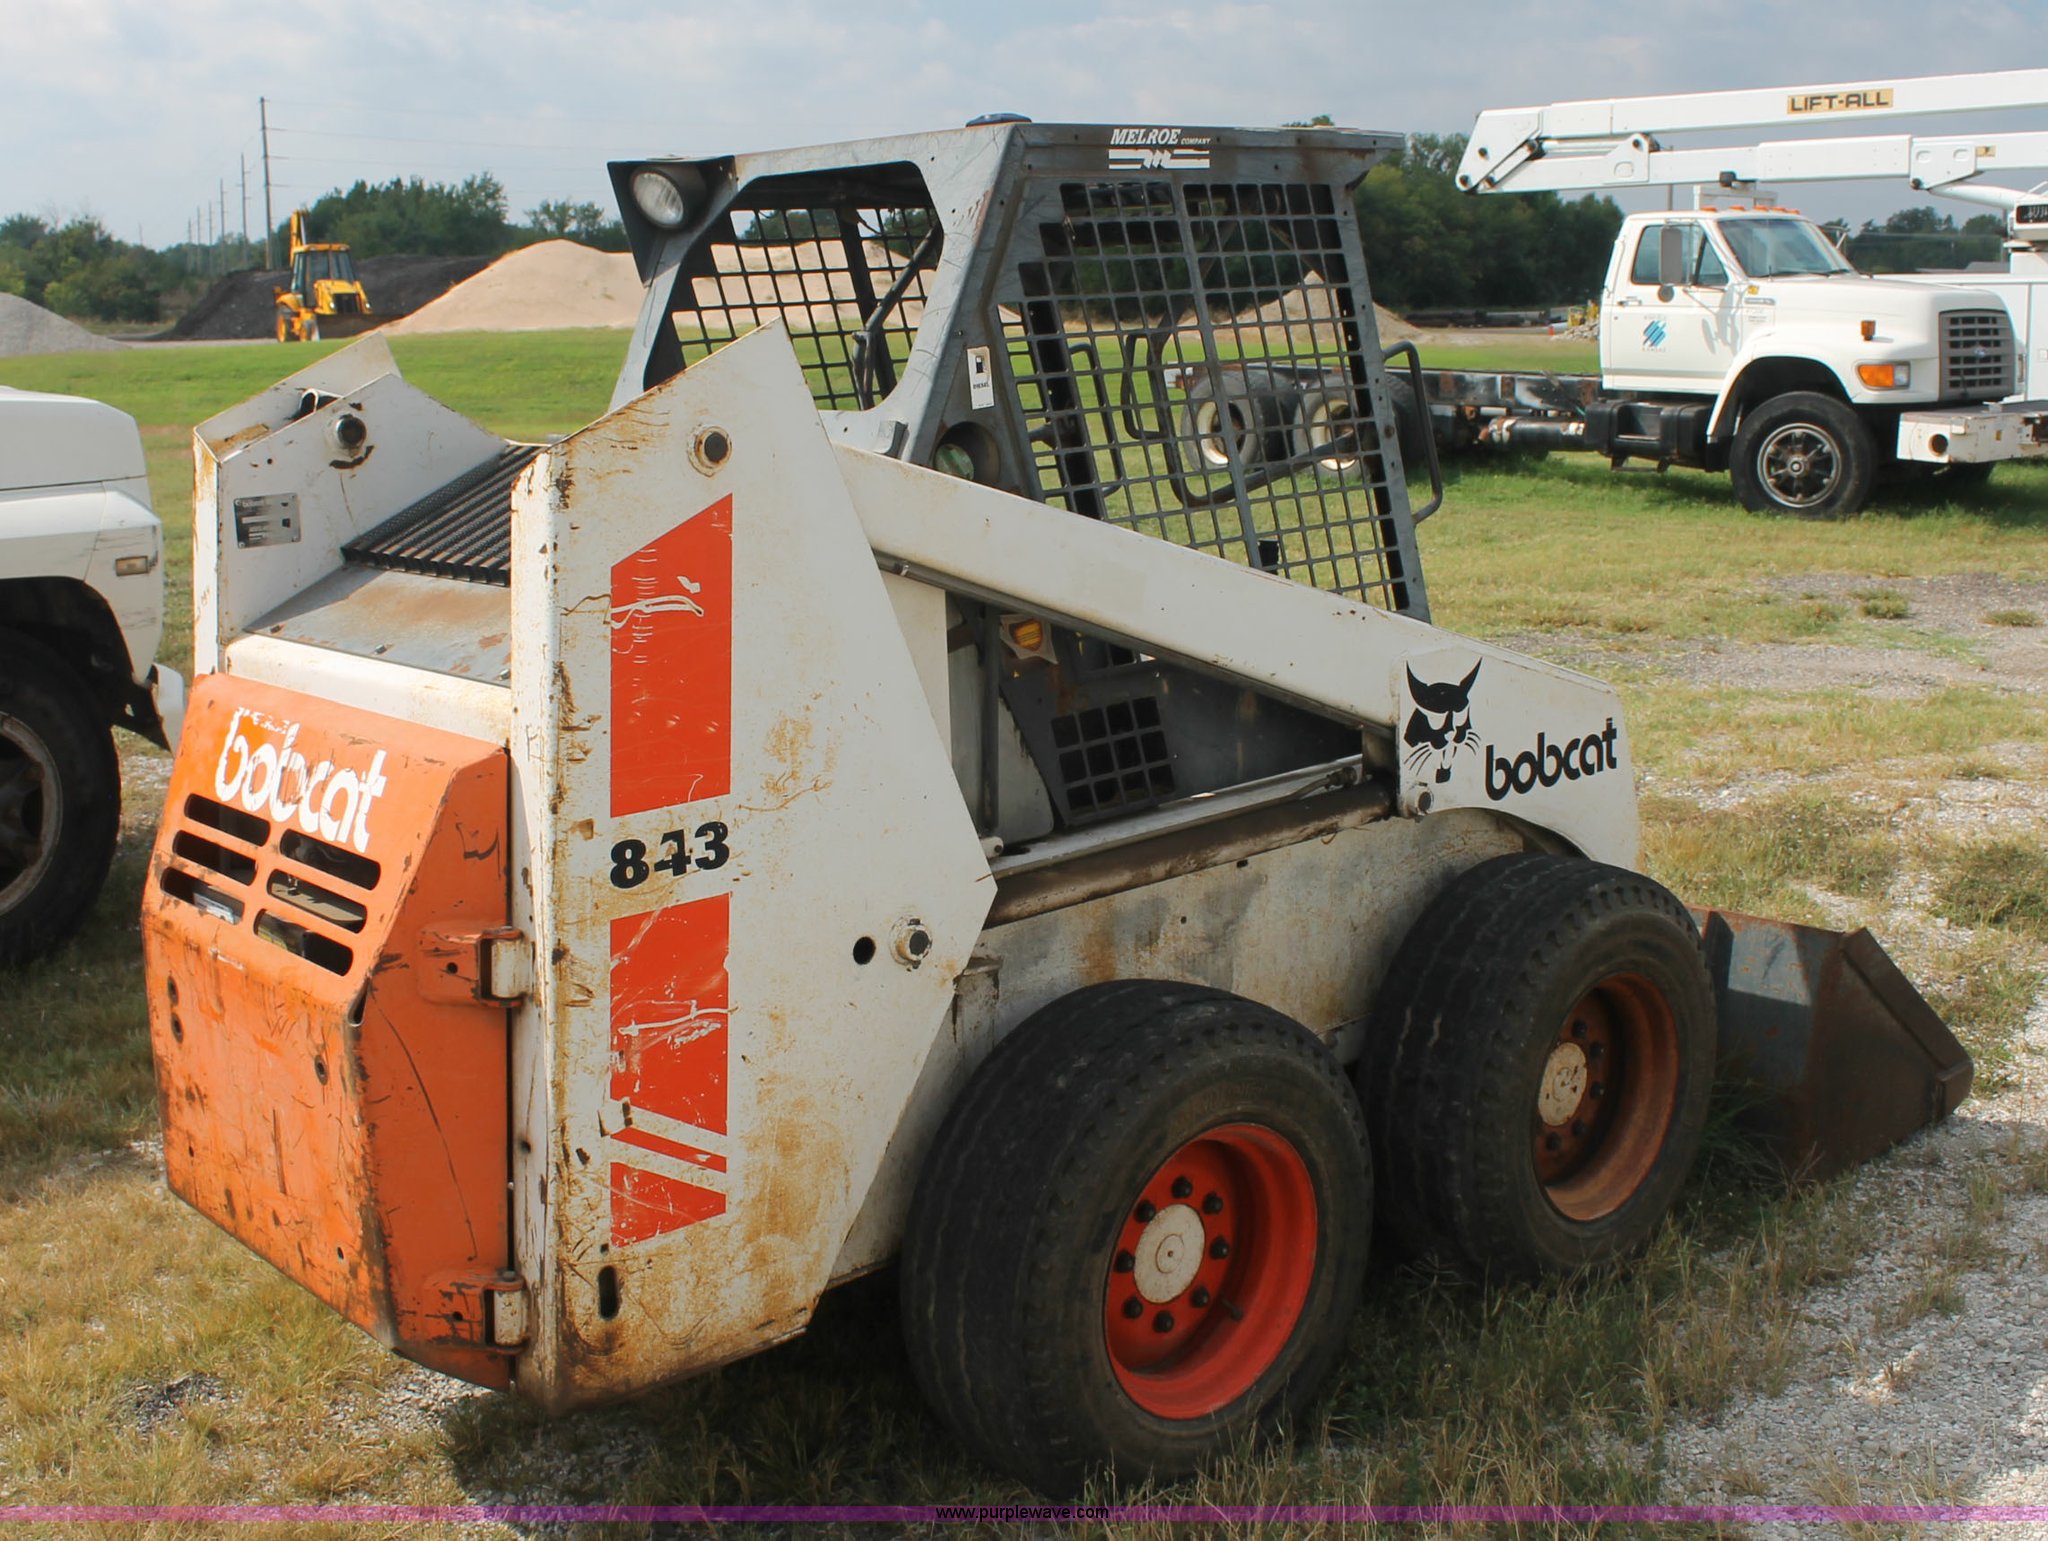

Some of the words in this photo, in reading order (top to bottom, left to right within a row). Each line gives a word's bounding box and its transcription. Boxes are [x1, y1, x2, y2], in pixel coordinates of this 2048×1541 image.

[1791, 92, 1889, 112] LIFT-ALL
[1110, 128, 1182, 145] MELROE
[1181, 137, 1211, 145] COMPANY
[215, 707, 387, 853] bobcat
[1485, 717, 1617, 801] bobcat
[610, 821, 730, 889] 843
